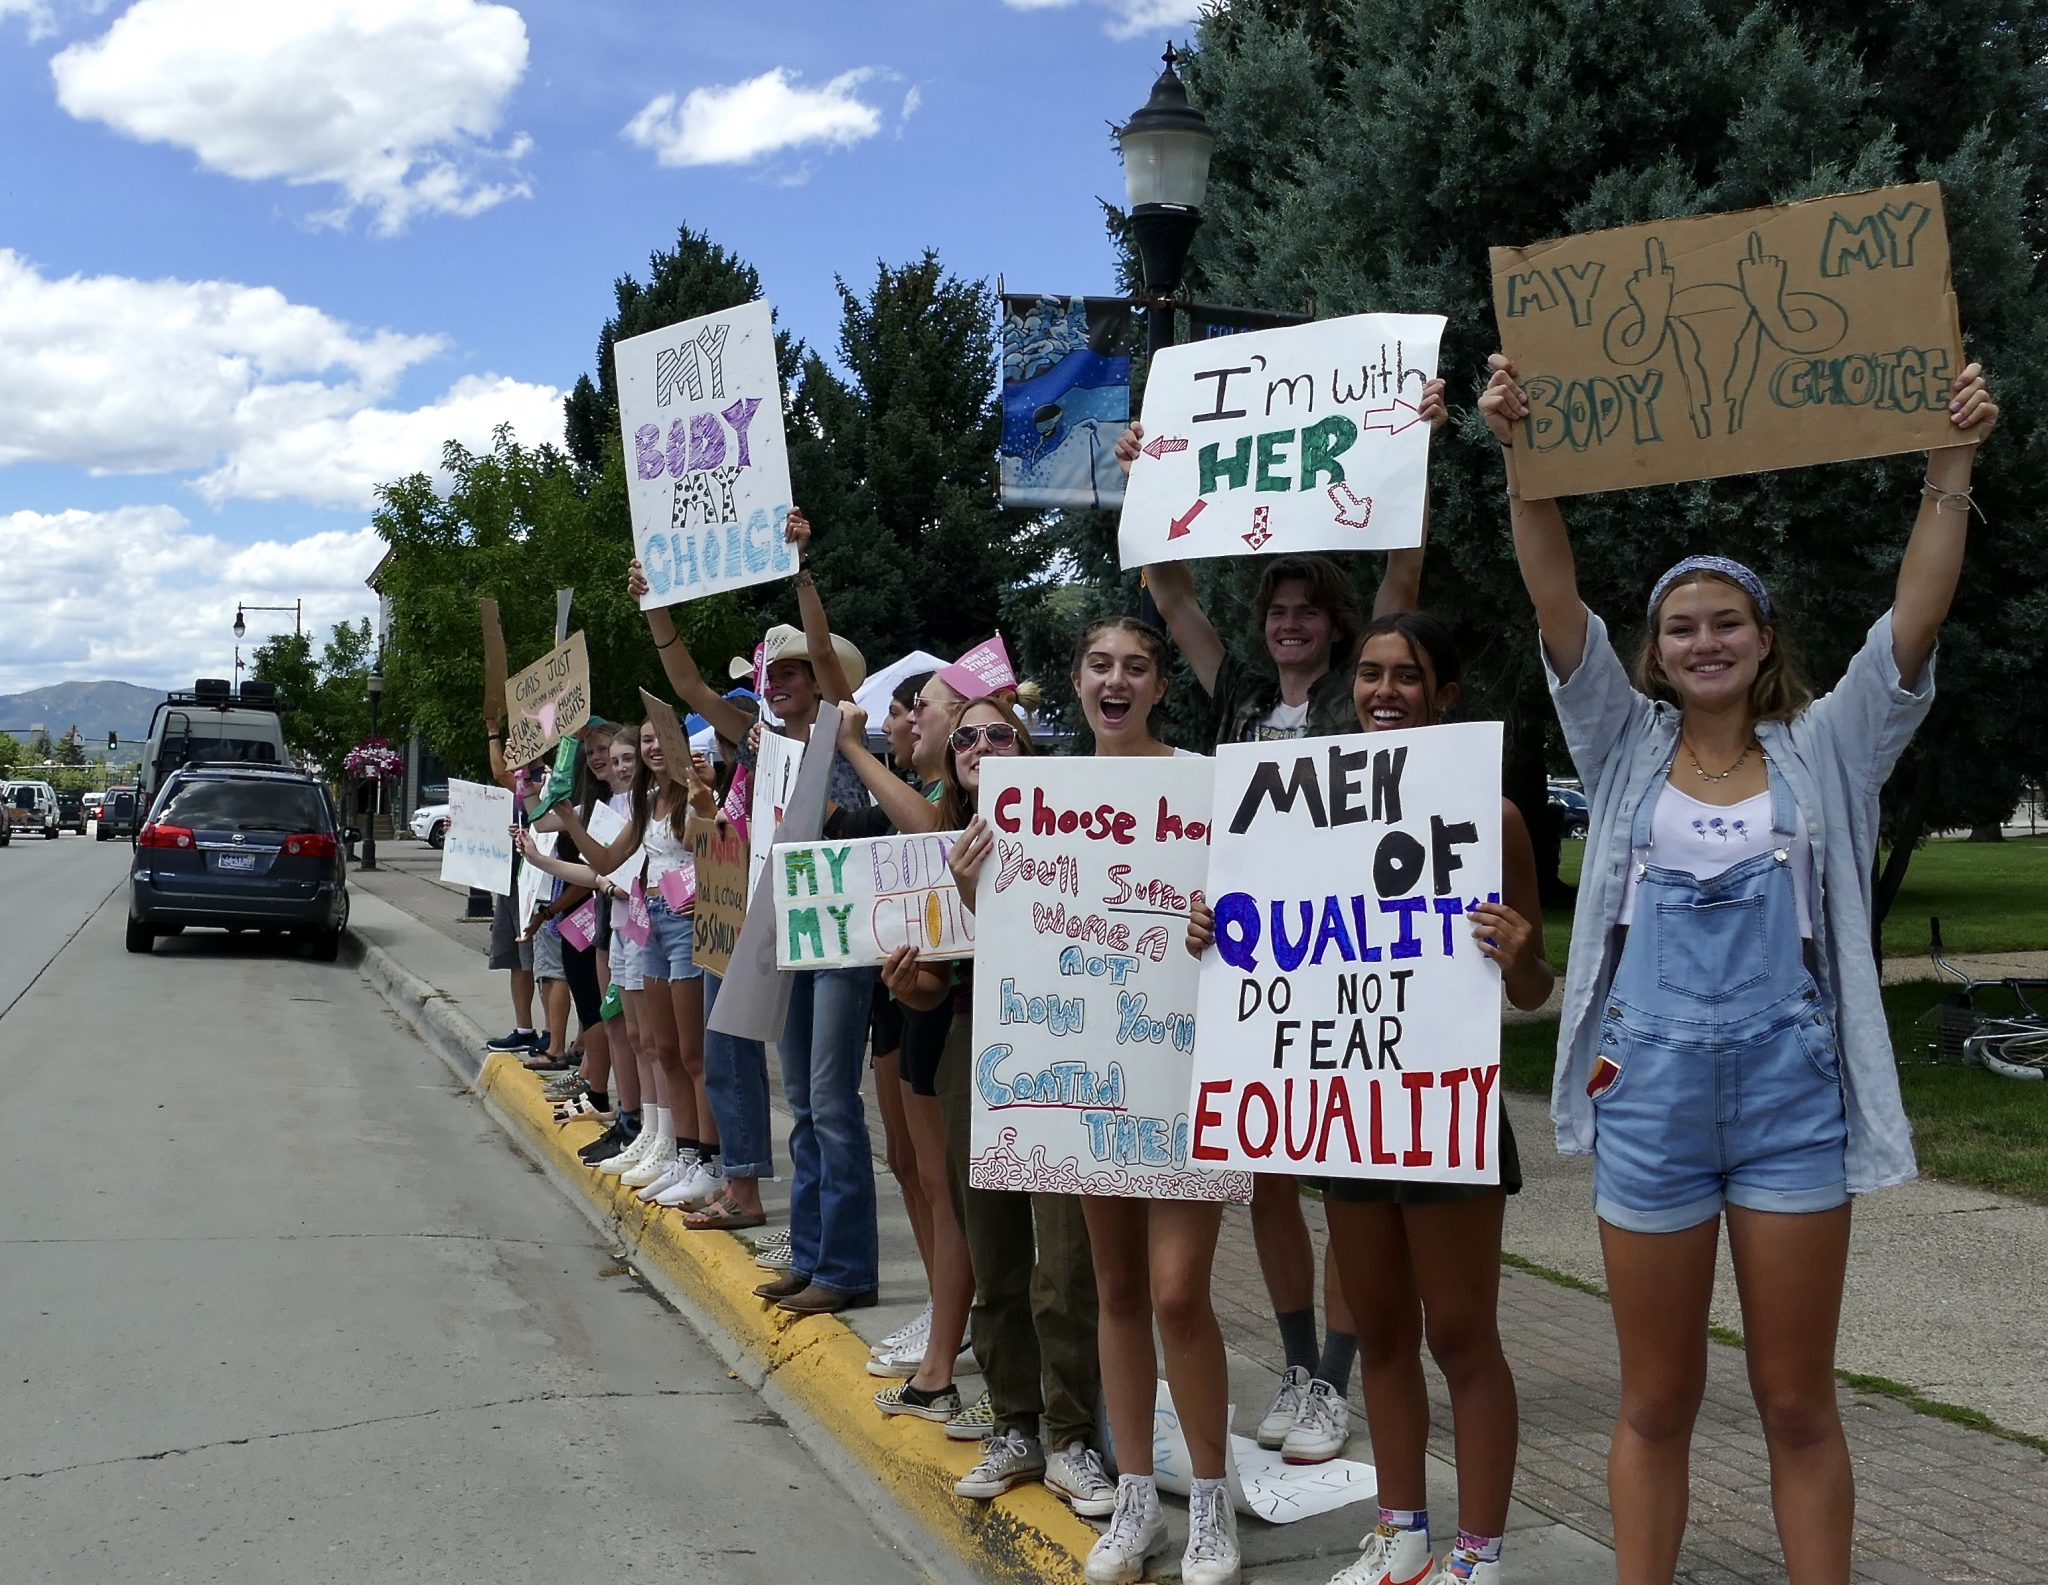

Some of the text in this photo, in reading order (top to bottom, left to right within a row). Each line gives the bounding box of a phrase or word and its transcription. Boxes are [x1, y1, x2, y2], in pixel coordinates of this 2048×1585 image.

[1820, 201, 1931, 279] MY
[1506, 262, 1606, 328] MY
[656, 325, 730, 407] MY
[1192, 340, 1428, 423] I'm with
[1769, 346, 1955, 415] CHOICE
[635, 398, 763, 481] BODY
[1520, 368, 1664, 453] BODY
[1198, 415, 1358, 496] HER
[671, 466, 743, 528] MY
[644, 504, 792, 596] CHOICE
[515, 648, 572, 702] GIRLS JUST
[557, 683, 582, 712] HUMAN
[555, 692, 586, 735] RIGHTS
[525, 742, 544, 760] TAL
[994, 786, 1137, 845] Choose
[1228, 745, 1408, 835] MEN
[695, 832, 708, 857] MY
[784, 844, 852, 897] MY
[994, 838, 1079, 898] You'll
[1372, 815, 1479, 899] OF
[787, 889, 976, 962] MY CHOIC
[999, 978, 1195, 1056] how You'll
[1238, 970, 1414, 1022] DO NOT
[1273, 1015, 1403, 1071] FEAR
[1191, 1064, 1500, 1171] EQUALITY
